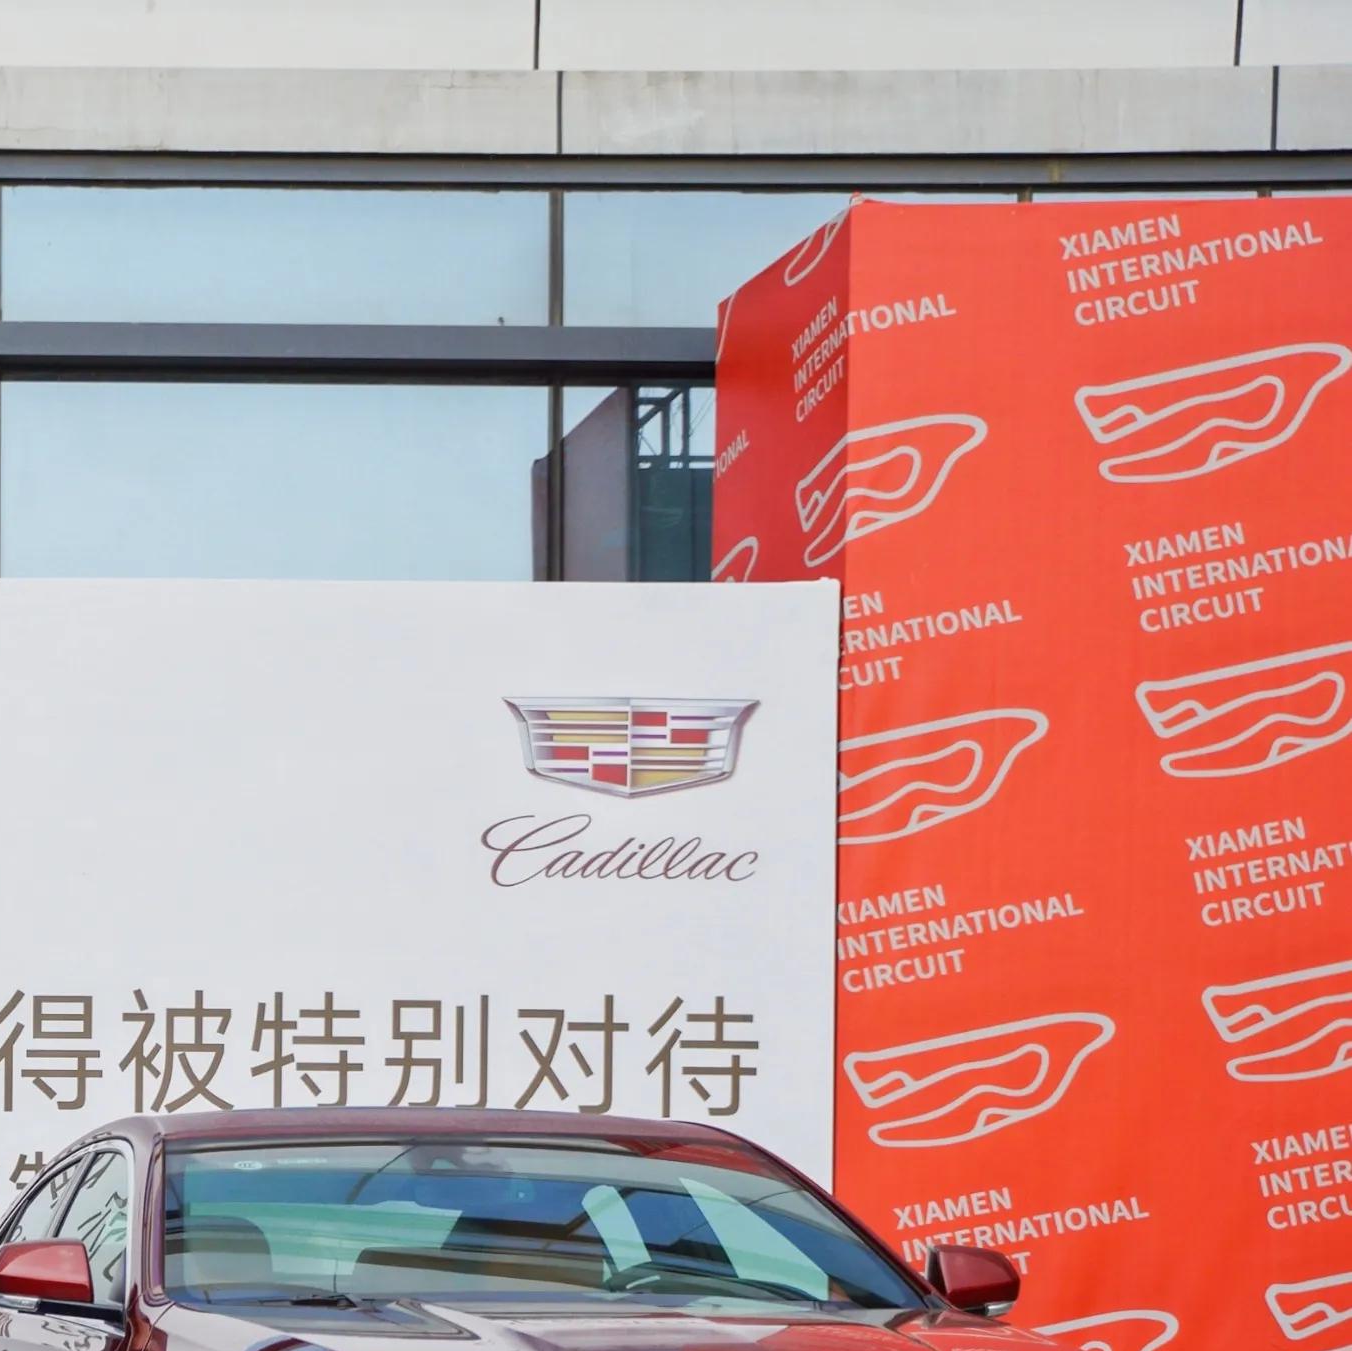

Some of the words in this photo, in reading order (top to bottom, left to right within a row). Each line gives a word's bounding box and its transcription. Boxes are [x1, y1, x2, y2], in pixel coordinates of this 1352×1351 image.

[1060, 214, 1181, 260] XIAMEN
[1066, 221, 1323, 293] INTERNATIONAL
[1074, 280, 1199, 326] CIRCUIT
[792, 296, 837, 363] XIAMEN
[794, 294, 957, 393] INTERNATIONAL
[796, 356, 844, 422] CIRCUIT
[713, 430, 750, 482] IONAL
[1124, 522, 1245, 567] XIAMEN
[1132, 535, 1352, 600] INTERNATION
[839, 599, 1023, 656] RNATIONAL
[1140, 588, 1264, 633] CIRCUIT
[480, 814, 759, 888] Cadillac
[1185, 816, 1306, 861] XIAMEN
[837, 893, 1084, 960] INTERNATIONAL
[1201, 881, 1325, 927] CIRCUIT
[843, 949, 965, 993] CIRCUIT
[1250, 1124, 1352, 1165] XIAME
[893, 1187, 1013, 1230] XIAMEN
